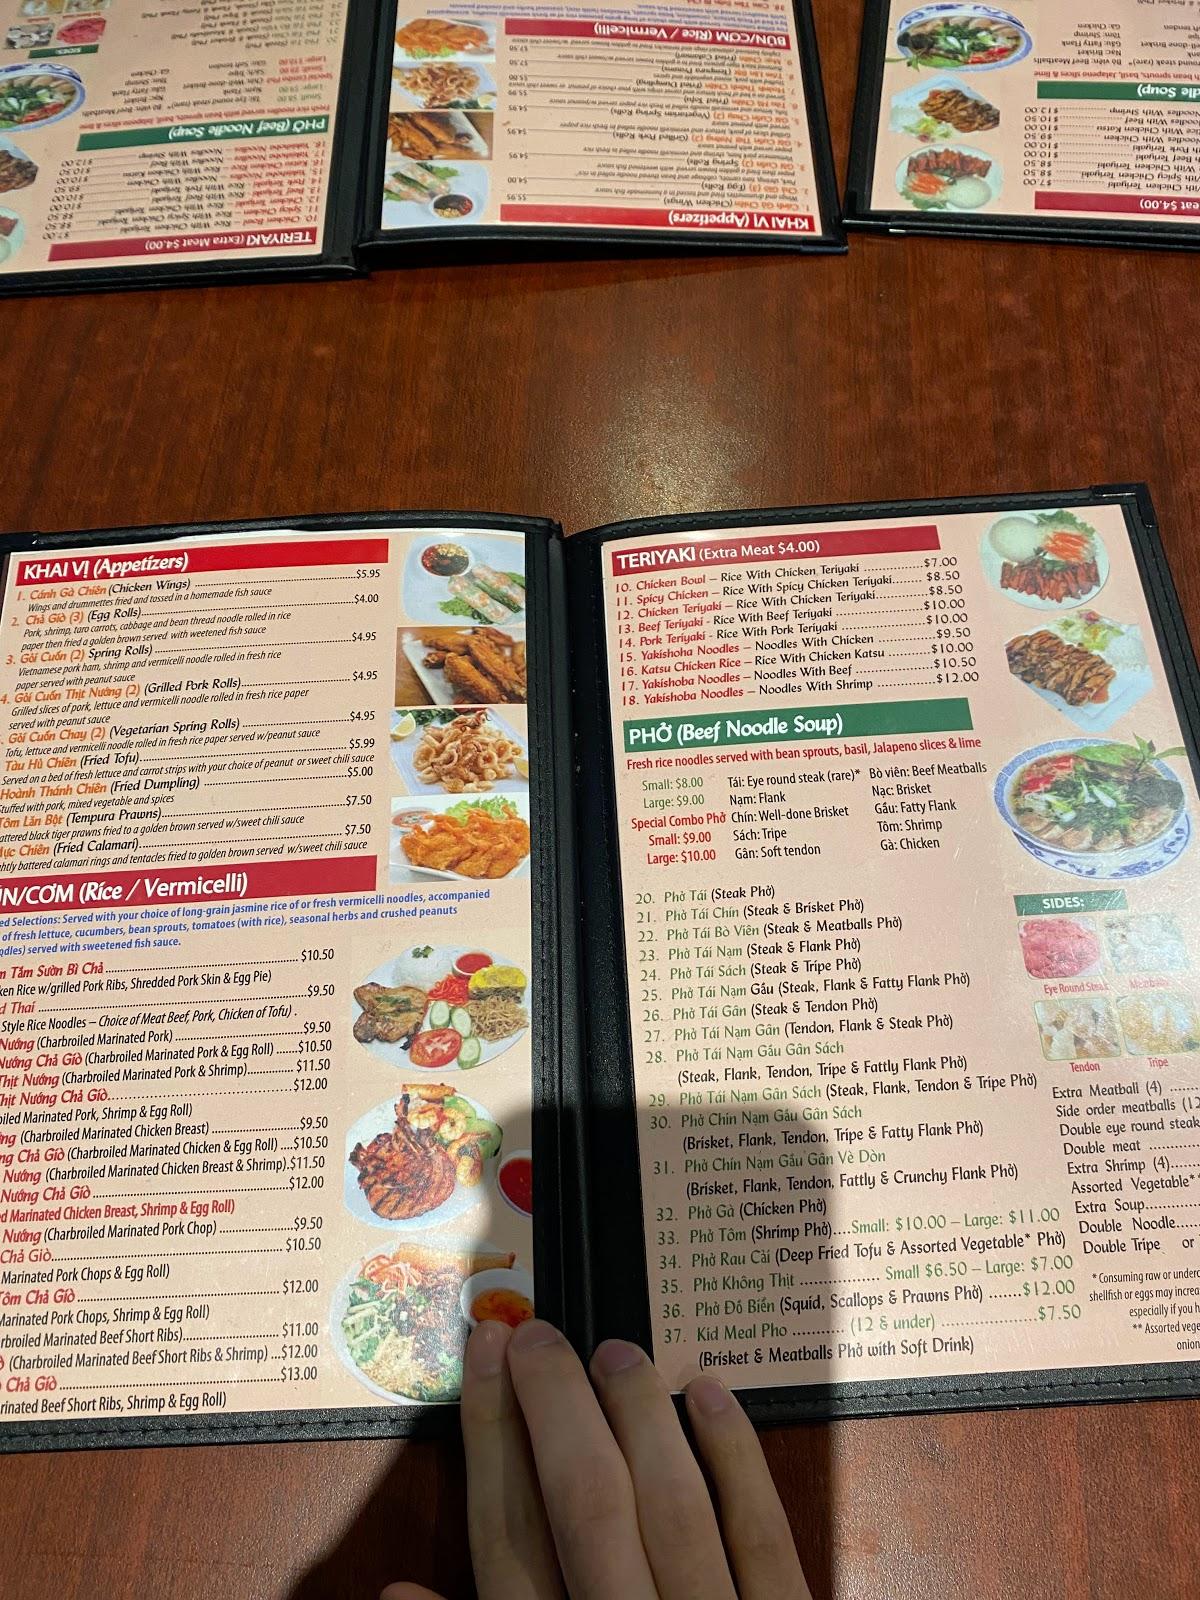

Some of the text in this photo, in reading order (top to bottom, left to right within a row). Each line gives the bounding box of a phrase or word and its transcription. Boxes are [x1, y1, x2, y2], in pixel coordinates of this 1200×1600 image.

[1137, 84, 1177, 98] Soup)
[168, 126, 206, 140] Soup)
[208, 122, 253, 136] Noodle
[256, 119, 291, 135] (Beef
[668, 211, 750, 228] (Appetizers)
[768, 215, 809, 230] KHAI
[246, 231, 312, 246] TERIYAKI
[616, 539, 820, 570] TERIYAKI (Extra Meat $4.00)
[24, 562, 69, 580] KHAI
[93, 552, 189, 576] (Appetizers)
[616, 583, 631, 592] 10.
[637, 579, 676, 590] Chicken
[681, 575, 705, 585] Bowl
[721, 573, 742, 582] Rice
[746, 570, 770, 579] With
[775, 567, 816, 578] Chicken
[821, 563, 859, 576] Teriyaki
[924, 557, 957, 568] $7.00
[18, 569, 380, 601] 1. Cánh Gà Chiên (Chicken Wings) $5.95
[29, 604, 50, 613] Wings
[52, 601, 68, 610] and
[68, 599, 113, 610] drummettes
[115, 596, 133, 605] fried
[134, 595, 149, 604] and
[150, 594, 174, 602] tossed
[175, 593, 182, 601] in
[190, 590, 234, 600] homemade
[235, 588, 248, 596] fish
[145, 671, 377, 696] (Grilled Pork Rolls) $4.95
[630, 714, 842, 746] PHỞ (Beef Noodle Soup)
[627, 758, 652, 770] Fresh
[656, 758, 672, 768] rice
[675, 754, 714, 766] noodles
[716, 752, 748, 763] served
[750, 750, 773, 760] with
[776, 750, 800, 759] bean
[803, 747, 842, 760] sprouts,
[844, 744, 870, 755] basil,
[874, 743, 917, 755] Jalapeno
[920, 740, 946, 750] slices
[959, 738, 981, 748] lime
[870, 762, 987, 778] Bò viên: Beef Meatballs
[642, 777, 703, 791] Small: $8.00
[728, 777, 744, 788] Tái:
[748, 776, 764, 789] Eye
[767, 773, 796, 785] round
[799, 772, 825, 783] steak
[644, 795, 704, 810] Large: $9.00
[758, 809, 811, 821] Well-done
[814, 806, 849, 818] Brisket
[632, 812, 726, 832] Special Combo Phở
[649, 832, 711, 846] Small: $9.00
[648, 851, 716, 866] Large: $10.00
[78, 882, 122, 905] (Rice
[145, 873, 248, 898] Vermicelli)
[636, 885, 775, 904] 20. Phở Tái (Steak Phở)
[1042, 896, 1086, 910] SIDES:
[37, 1021, 330, 1050] (Charbroiled Marinated Pork) $9.50
[1069, 1061, 1102, 1072] Tendon
[1148, 1057, 1168, 1070] Tripe
[1053, 1082, 1162, 1098] Extra Meatball (4)
[1079, 1218, 1175, 1234] Double Noodle
[662, 1280, 682, 1294] 35.
[694, 1278, 717, 1292] Phở
[723, 1276, 764, 1292] Không
[769, 1273, 794, 1289] Thịt
[886, 1266, 919, 1280] Small
[926, 1263, 967, 1278] $6.50
[986, 1261, 1024, 1276] Large:
[1031, 1256, 1073, 1271] $7.00
[1130, 1304, 1193, 1318] especially if you
[665, 1330, 686, 1344] 37.
[698, 1328, 718, 1342] Kid
[725, 1326, 756, 1340] Meal
[851, 1318, 872, 1336] (12
[894, 1315, 934, 1332] under)
[1038, 1305, 1081, 1321] $7.50
[282, 1345, 318, 1360] $12.00
[281, 1367, 317, 1382] $13.00
